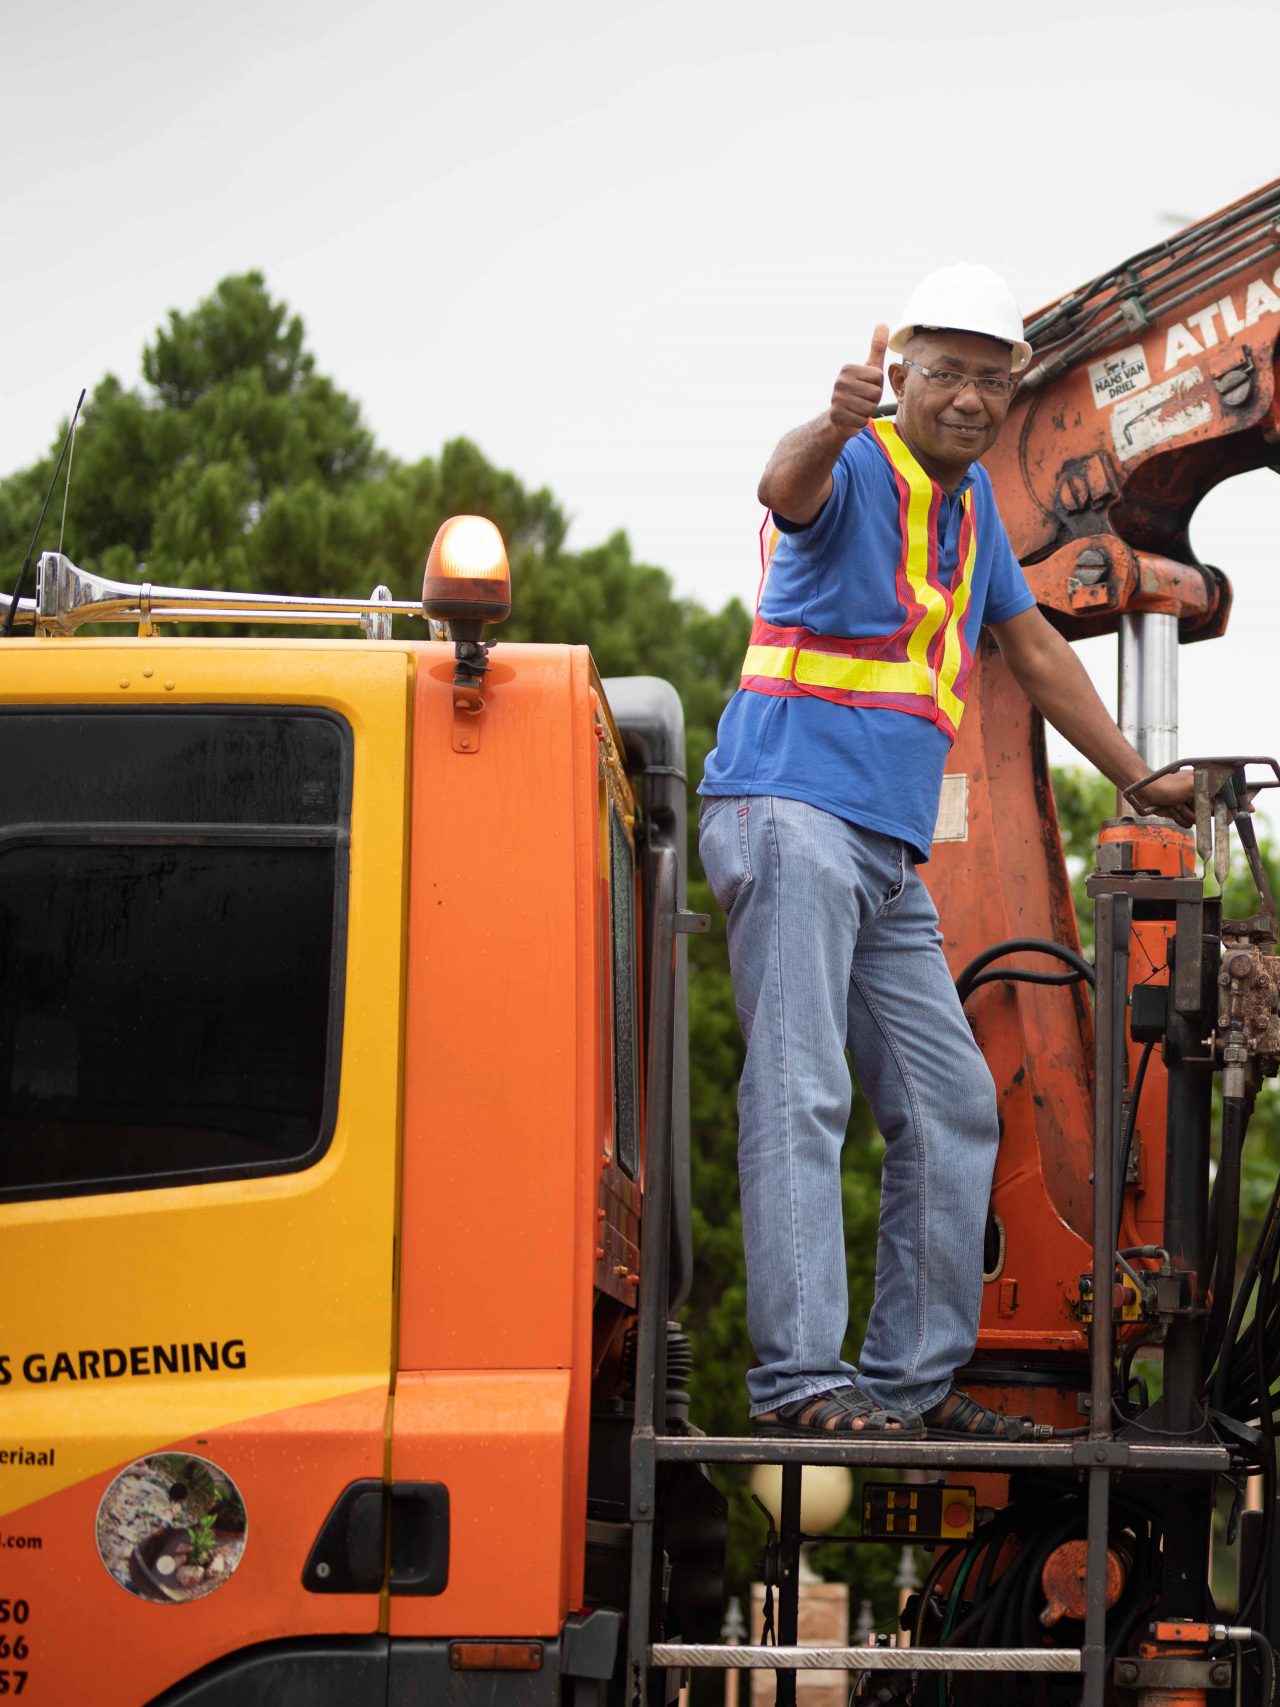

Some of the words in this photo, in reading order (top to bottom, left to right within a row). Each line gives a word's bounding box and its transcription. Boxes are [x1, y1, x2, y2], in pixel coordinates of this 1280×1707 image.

[1095, 372, 1123, 394] HANS
[1123, 361, 1145, 379] VAN
[1109, 379, 1137, 399] DRIEL
[23, 1340, 247, 1384] GARDENING
[0, 1532, 42, 1550] .com
[0, 1599, 29, 1625] 50
[0, 1634, 29, 1660] 66
[0, 1670, 28, 1695] 57
